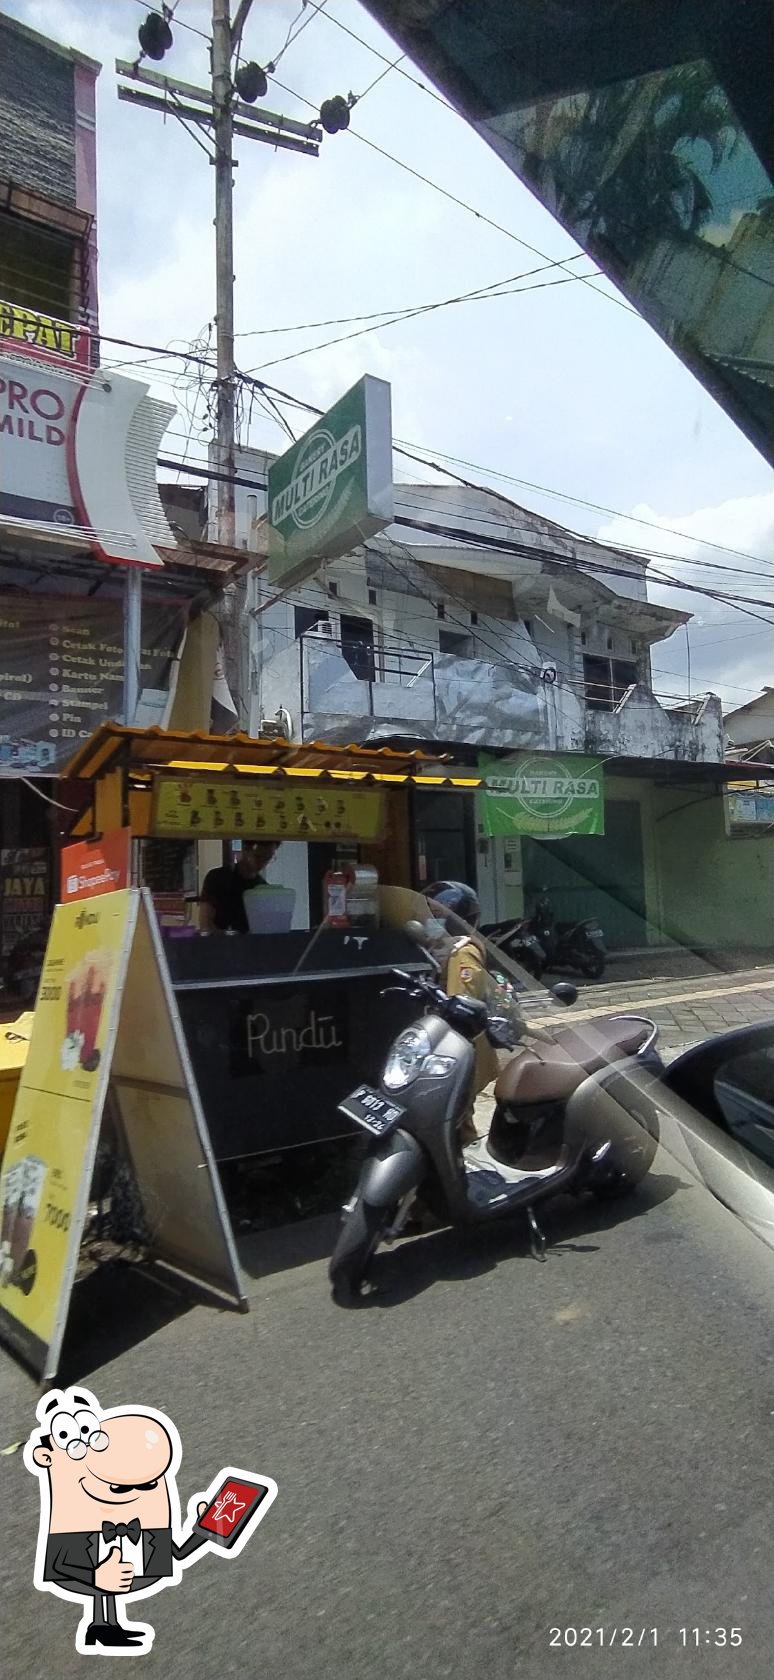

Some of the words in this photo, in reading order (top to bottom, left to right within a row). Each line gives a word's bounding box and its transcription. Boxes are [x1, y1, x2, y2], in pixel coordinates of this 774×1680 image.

[274, 467, 316, 522] MULTI
[319, 430, 361, 482] RASA
[62, 713, 82, 723] Pin
[62, 728, 76, 738] ID
[552, 780, 599, 795] RASA
